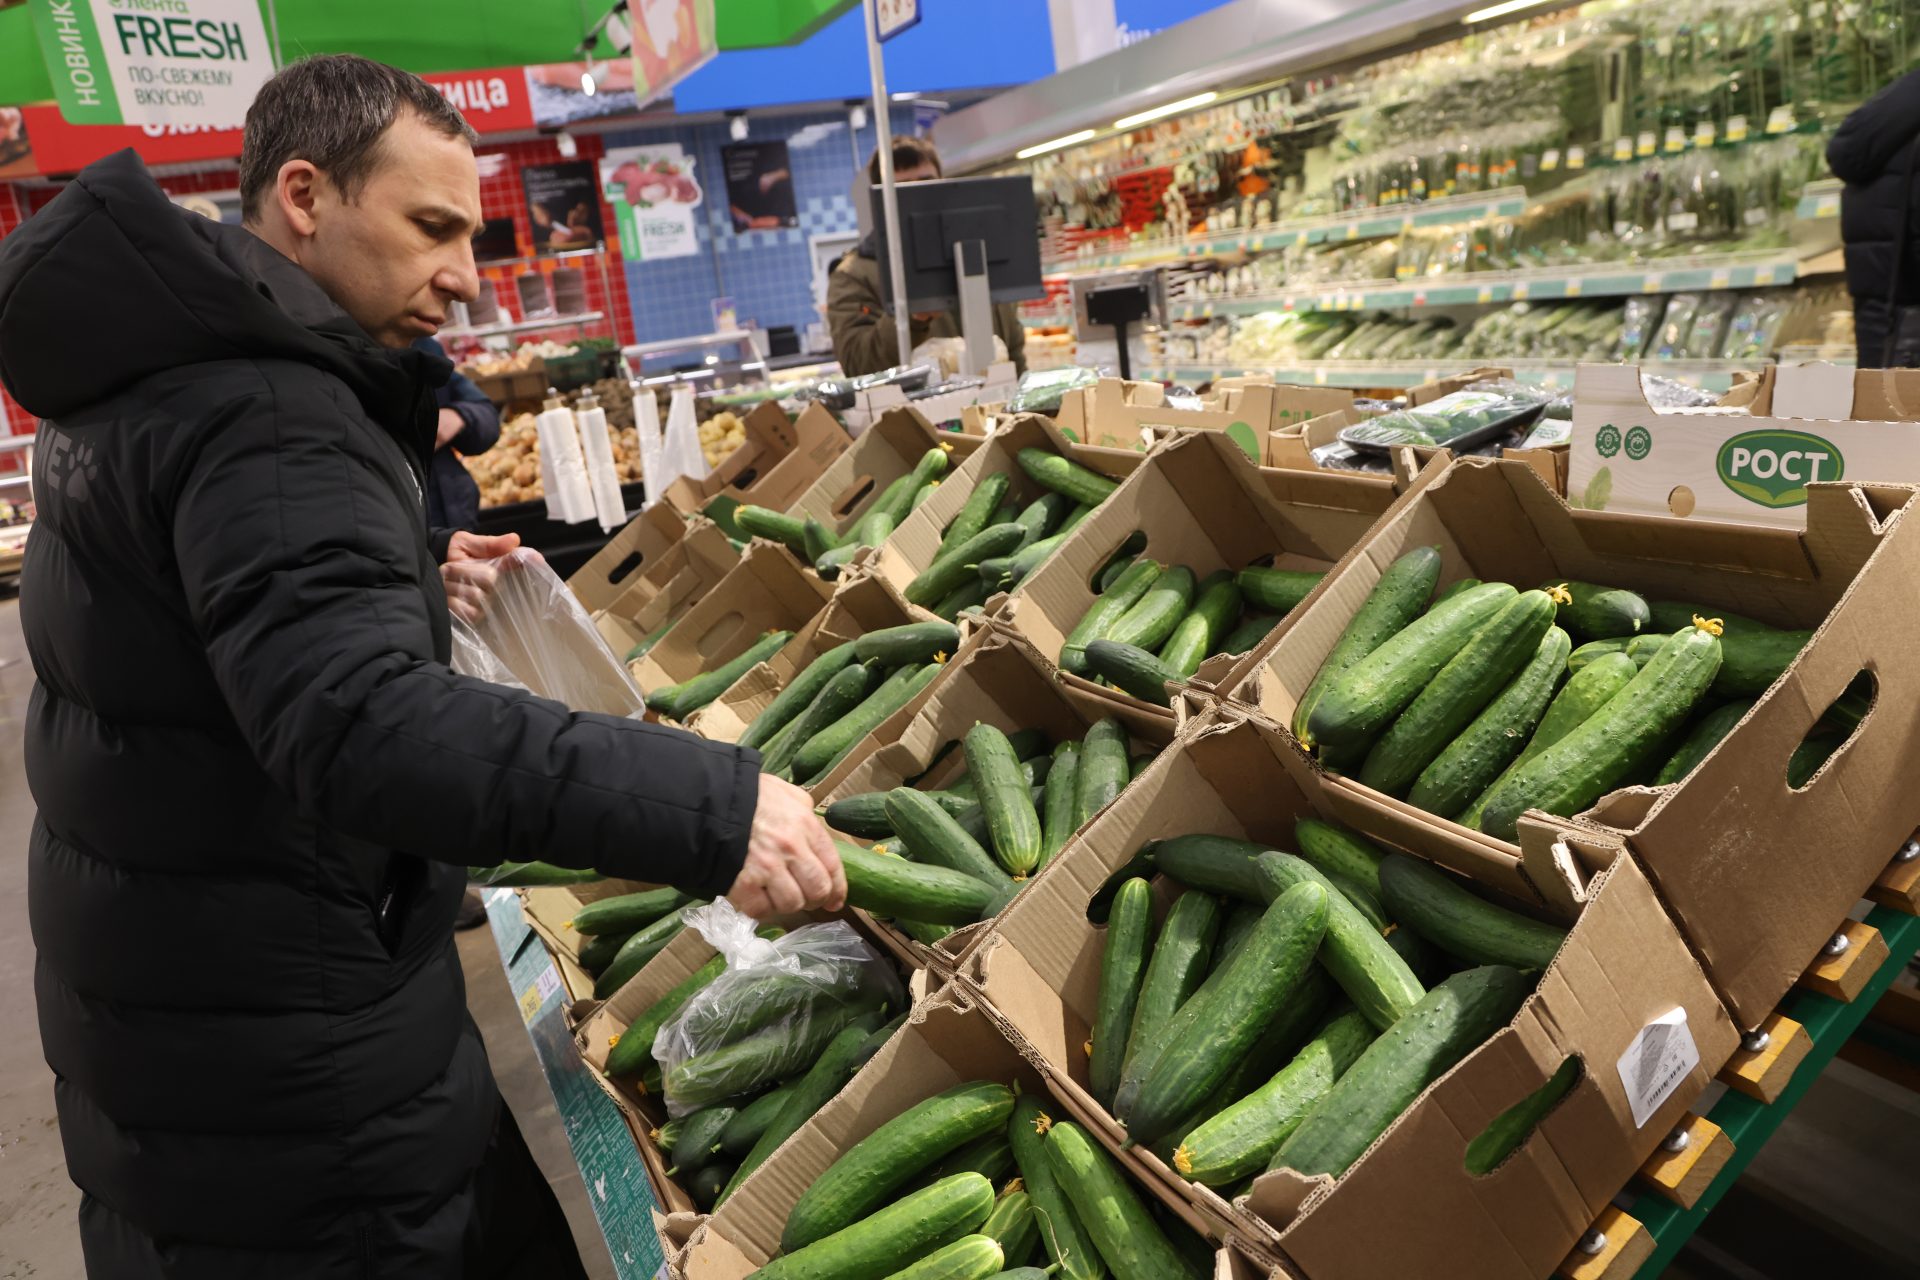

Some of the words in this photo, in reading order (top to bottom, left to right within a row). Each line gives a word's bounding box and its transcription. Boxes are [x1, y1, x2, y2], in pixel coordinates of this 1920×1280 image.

[113, 14, 248, 61] FRESH
[128, 66, 233, 86] ПО-СВЕЖЕМУ
[134, 88, 206, 107] ВКУСНО!
[431, 77, 510, 113] ица
[1731, 447, 1829, 483] РОСТ
